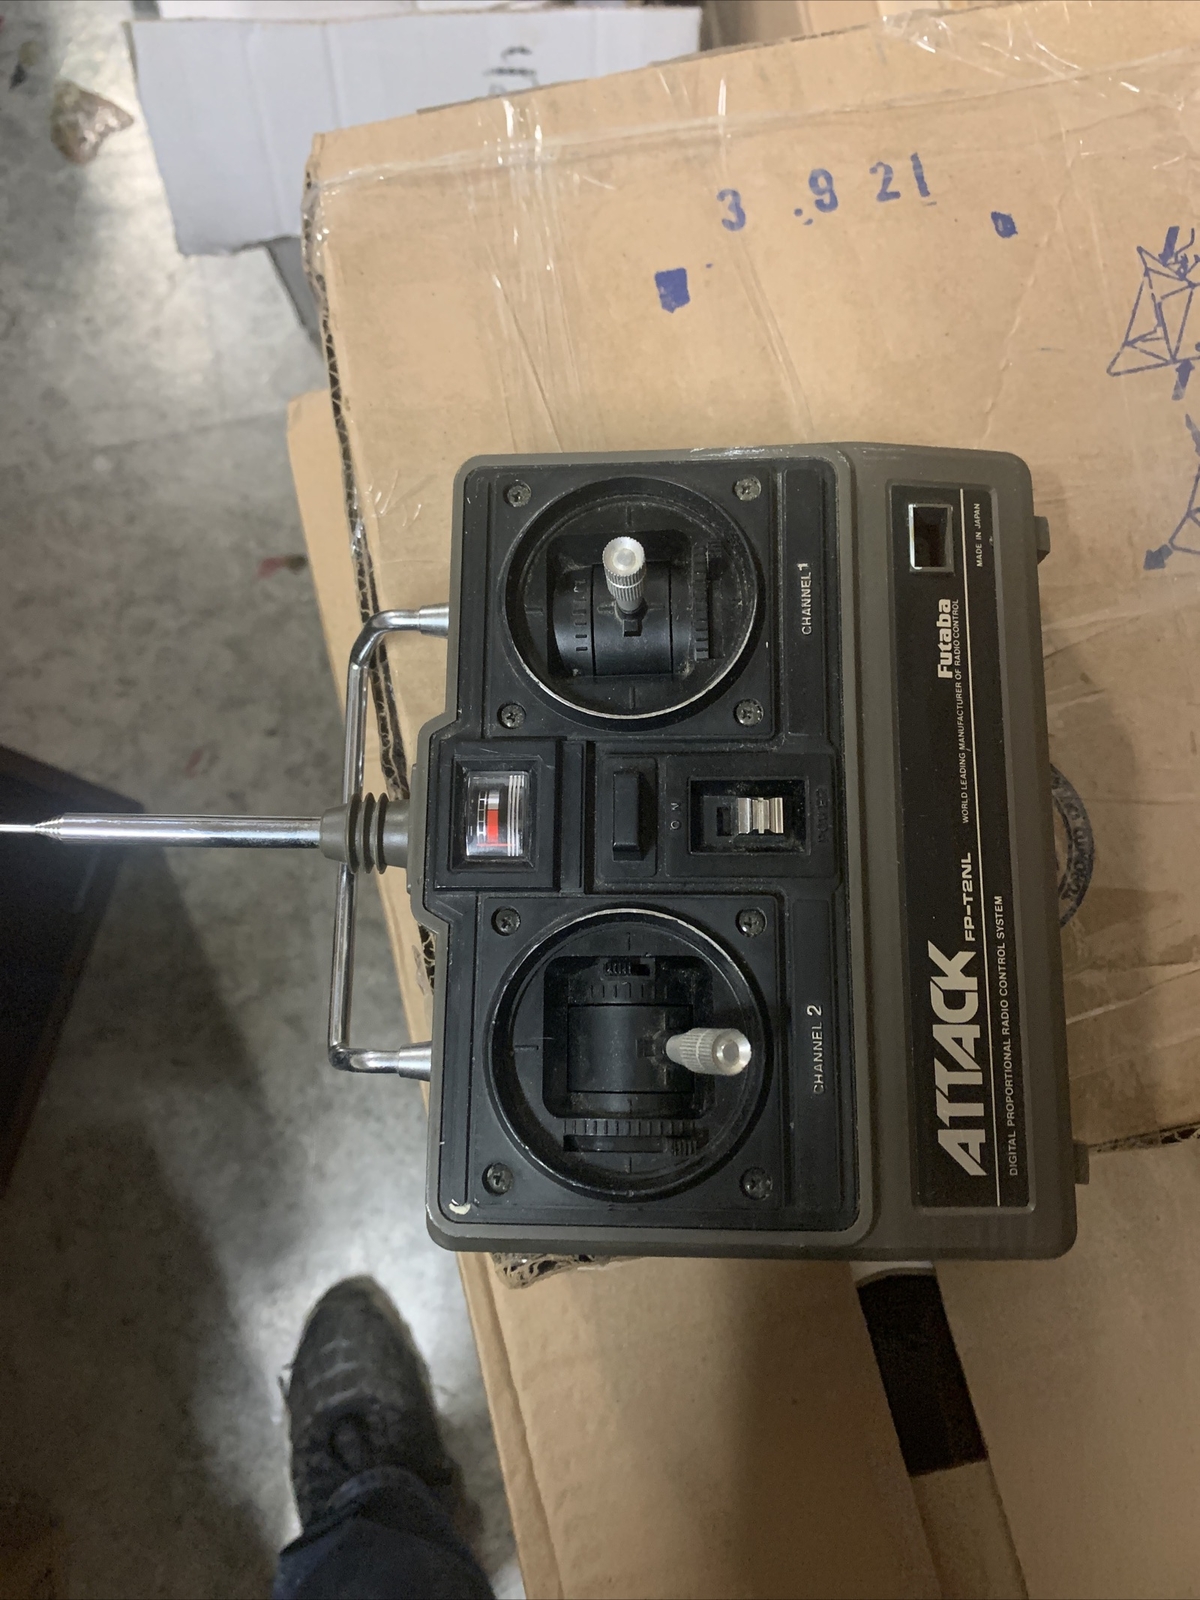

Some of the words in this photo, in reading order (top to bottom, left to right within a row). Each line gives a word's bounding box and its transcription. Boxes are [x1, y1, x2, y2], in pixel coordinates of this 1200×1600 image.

[975, 531, 982, 542] IN
[797, 563, 809, 571] 1
[801, 572, 812, 635] CHANNEL
[952, 599, 960, 640] CONTROL
[936, 598, 953, 679] Futaba
[953, 640, 961, 667] RADIO
[954, 669, 962, 681] OF
[955, 682, 965, 750] MANUFACTURER
[959, 752, 968, 791] LEADING
[816, 787, 829, 844] POWER
[993, 895, 1005, 940] SYSTEM
[996, 942, 1009, 996] CONTROL
[806, 1004, 822, 1016] 2
[928, 940, 988, 1176] ATTACK
[961, 852, 976, 942] FP-T2NL
[999, 998, 1011, 1036] RADIO
[811, 1021, 824, 1094] CHANNEL
[1001, 1038, 1015, 1127] PROPORTIONAL
[1008, 1130, 1018, 1176] DIGITAL
